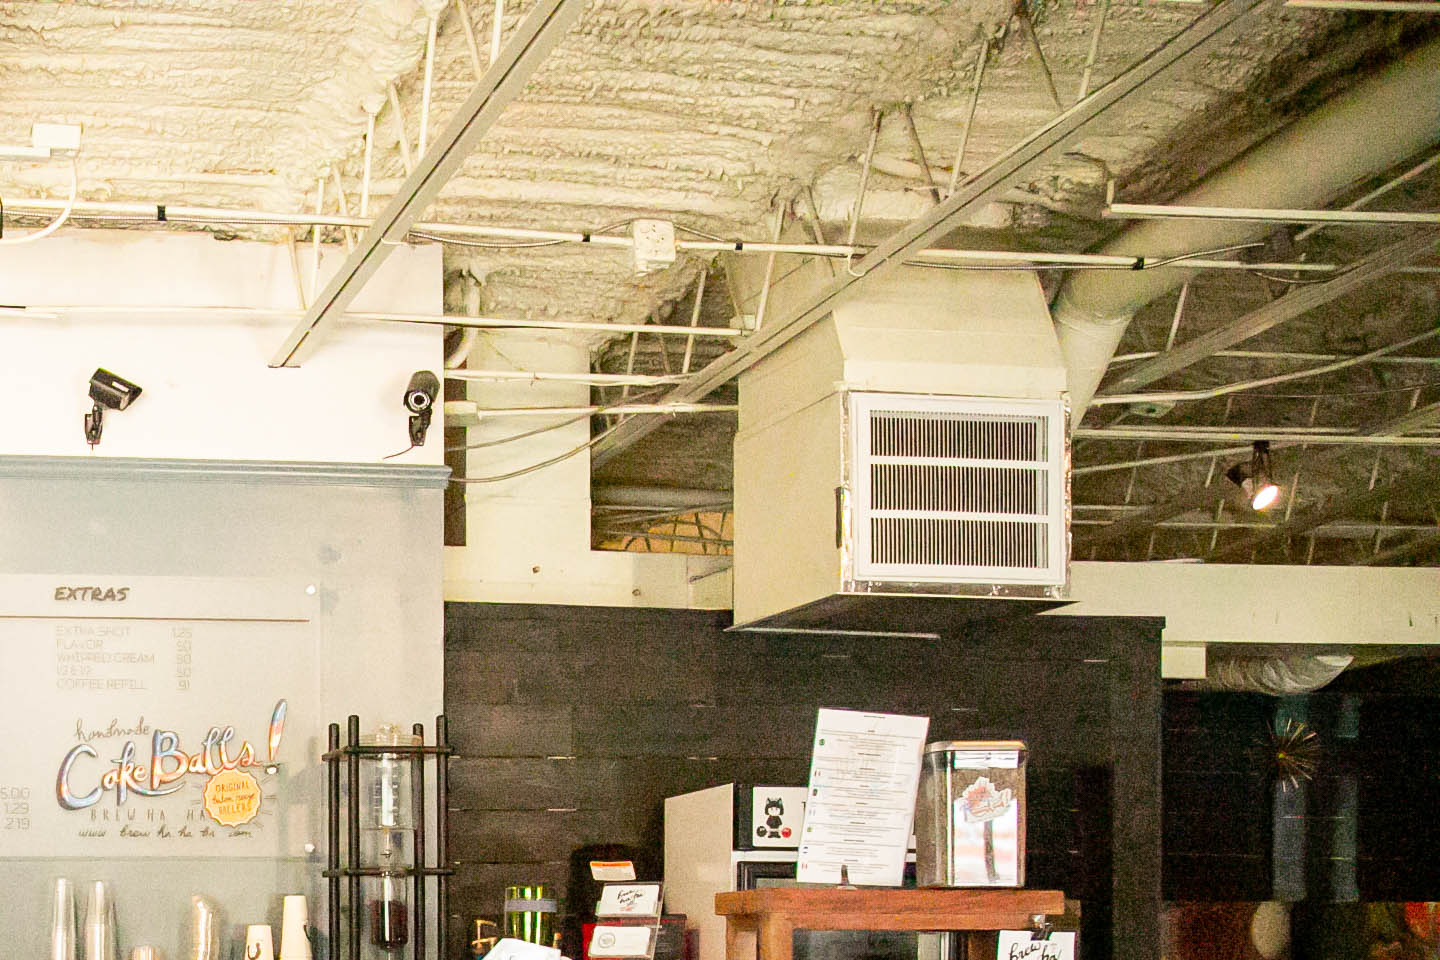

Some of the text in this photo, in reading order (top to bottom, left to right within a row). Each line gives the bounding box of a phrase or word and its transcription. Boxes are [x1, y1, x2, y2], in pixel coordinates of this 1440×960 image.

[55, 587, 130, 601] EXTRAS
[56, 678, 105, 690] COFFEE
[76, 716, 150, 742] handmade
[56, 698, 288, 811] Cake Balls!
[91, 808, 206, 821] BREW HA HA
